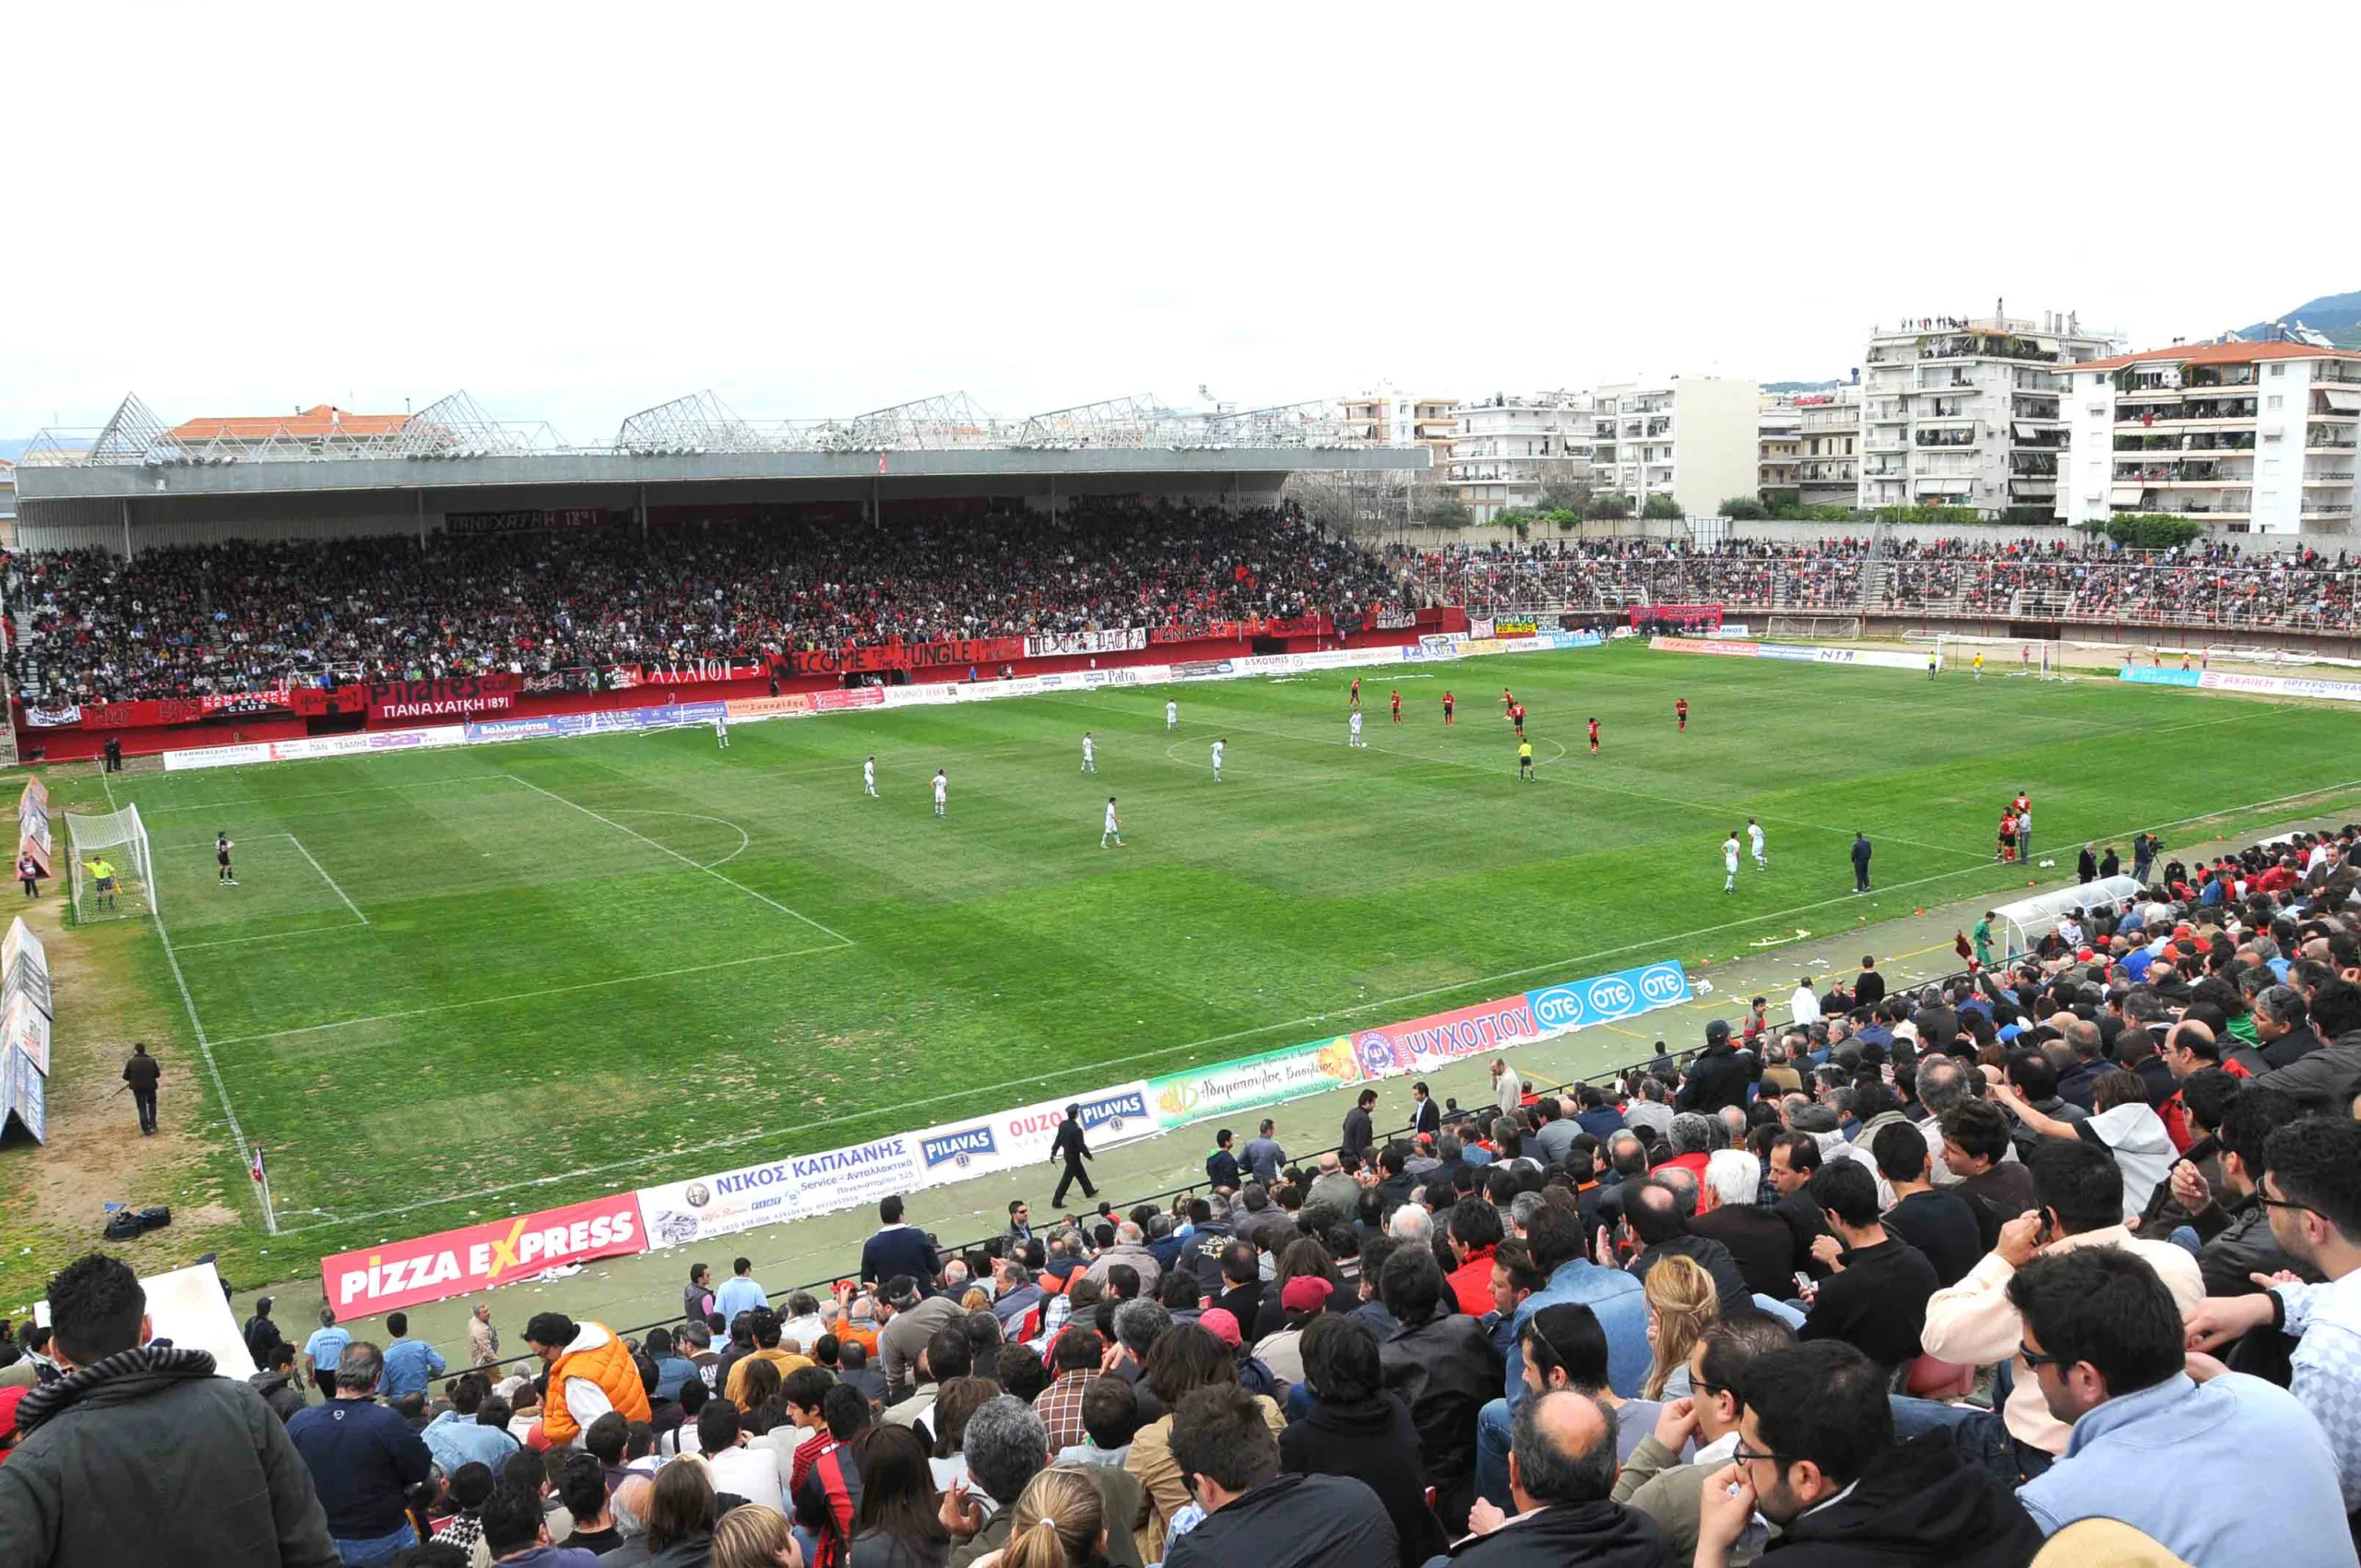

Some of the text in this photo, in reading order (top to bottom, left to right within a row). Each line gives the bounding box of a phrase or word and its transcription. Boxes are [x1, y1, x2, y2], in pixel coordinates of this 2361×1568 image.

[1497, 615, 1534, 624] NAVAJO
[1498, 624, 1508, 633] 20
[1521, 624, 1533, 632] 05
[1096, 627, 1145, 650] PATRA
[1108, 669, 1136, 683] Patra
[371, 677, 481, 706] Pirates
[203, 700, 232, 708] RED
[241, 695, 291, 706] BLACK
[228, 704, 267, 713] CLUB
[487, 696, 509, 709] 1891
[481, 721, 550, 735] Βαλλιανάτος
[1405, 1006, 1534, 1055] ΨΥΧΟΓΙΟΥ
[1082, 1097, 1142, 1124] PILAVAS
[1009, 1111, 1062, 1137] OUZO
[925, 1133, 991, 1160] PILAVAS
[716, 1139, 907, 1196] ΝΙΚΟΣ ΚΑΠΛΑΝΗΣ
[801, 1176, 838, 1191] Service
[752, 1196, 782, 1210] FIAT
[469, 1210, 635, 1280] EXPRESS
